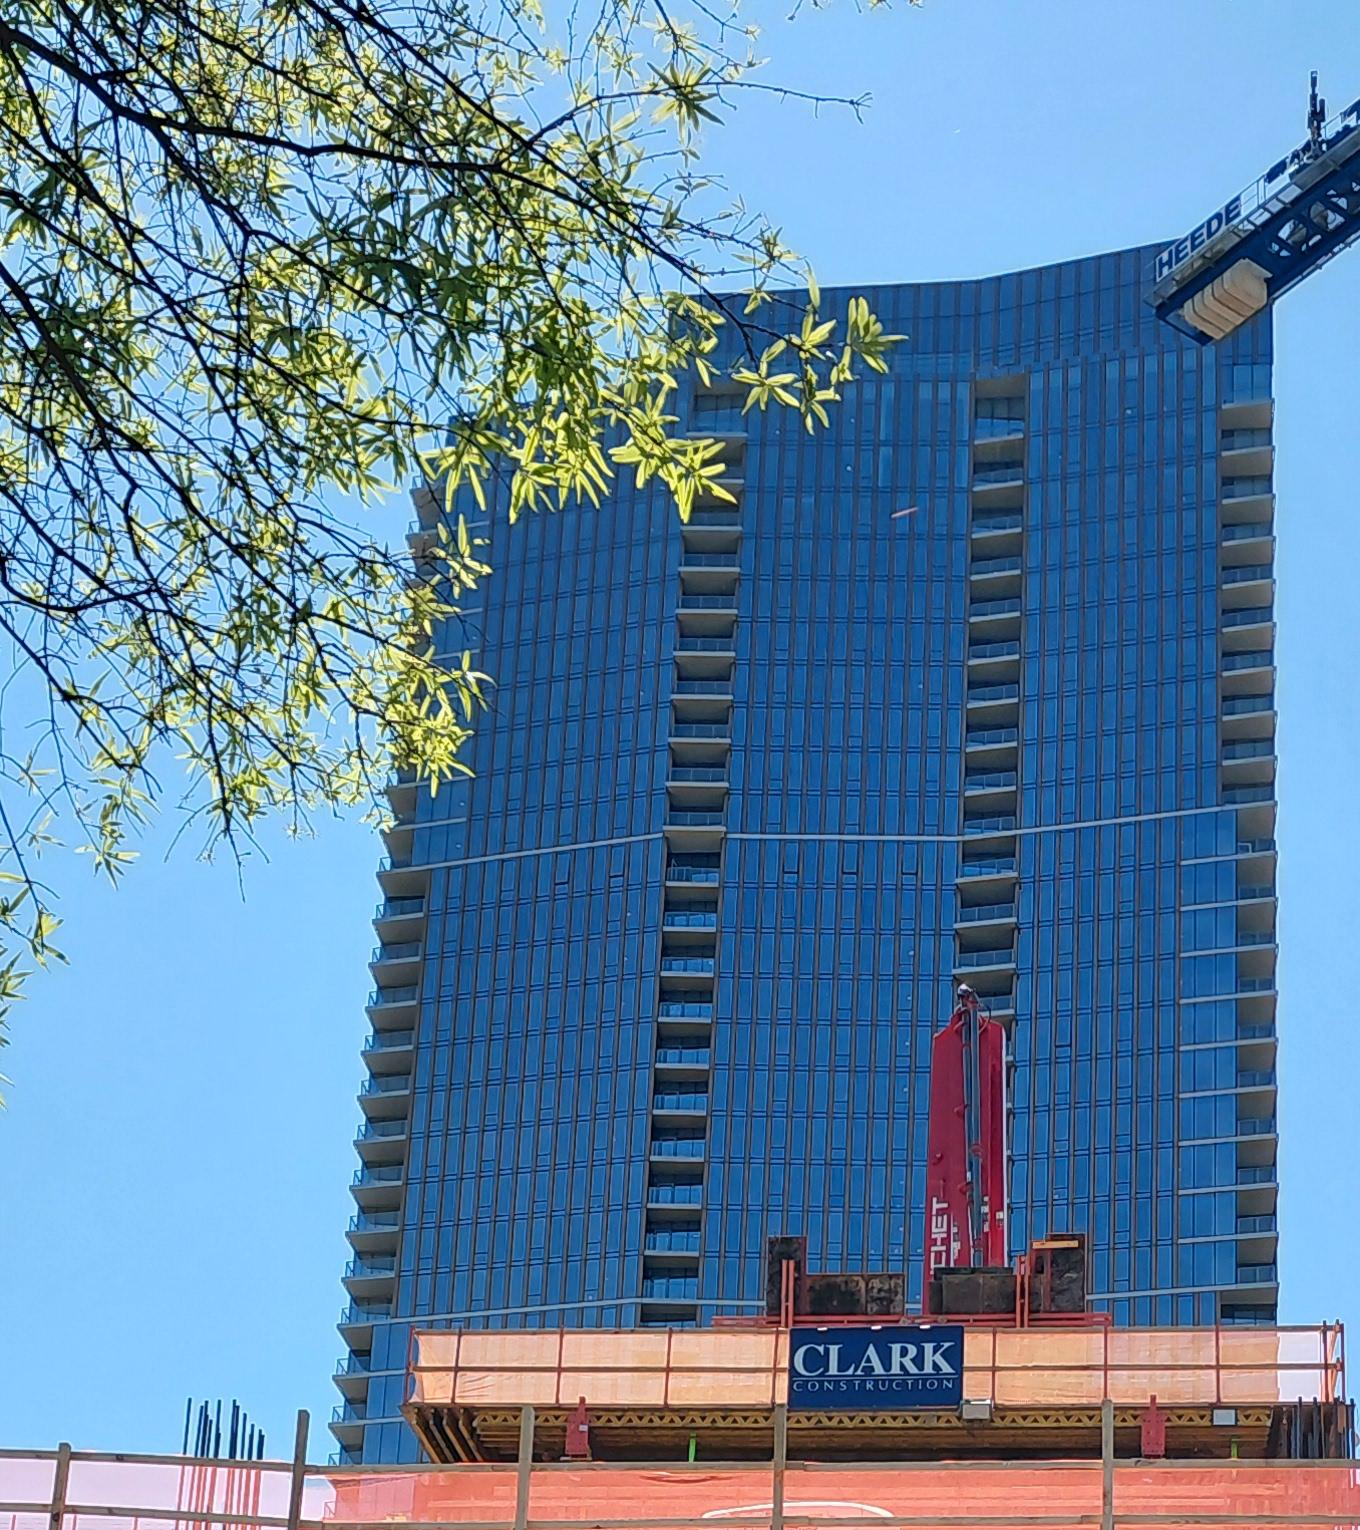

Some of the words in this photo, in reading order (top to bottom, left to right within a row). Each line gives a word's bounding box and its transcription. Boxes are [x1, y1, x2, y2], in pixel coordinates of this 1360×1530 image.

[1158, 194, 1240, 279] HEEDE
[930, 1197, 948, 1275] CHET
[793, 1342, 956, 1376] CLARK
[793, 1380, 954, 1392] CONSTRUCTION
